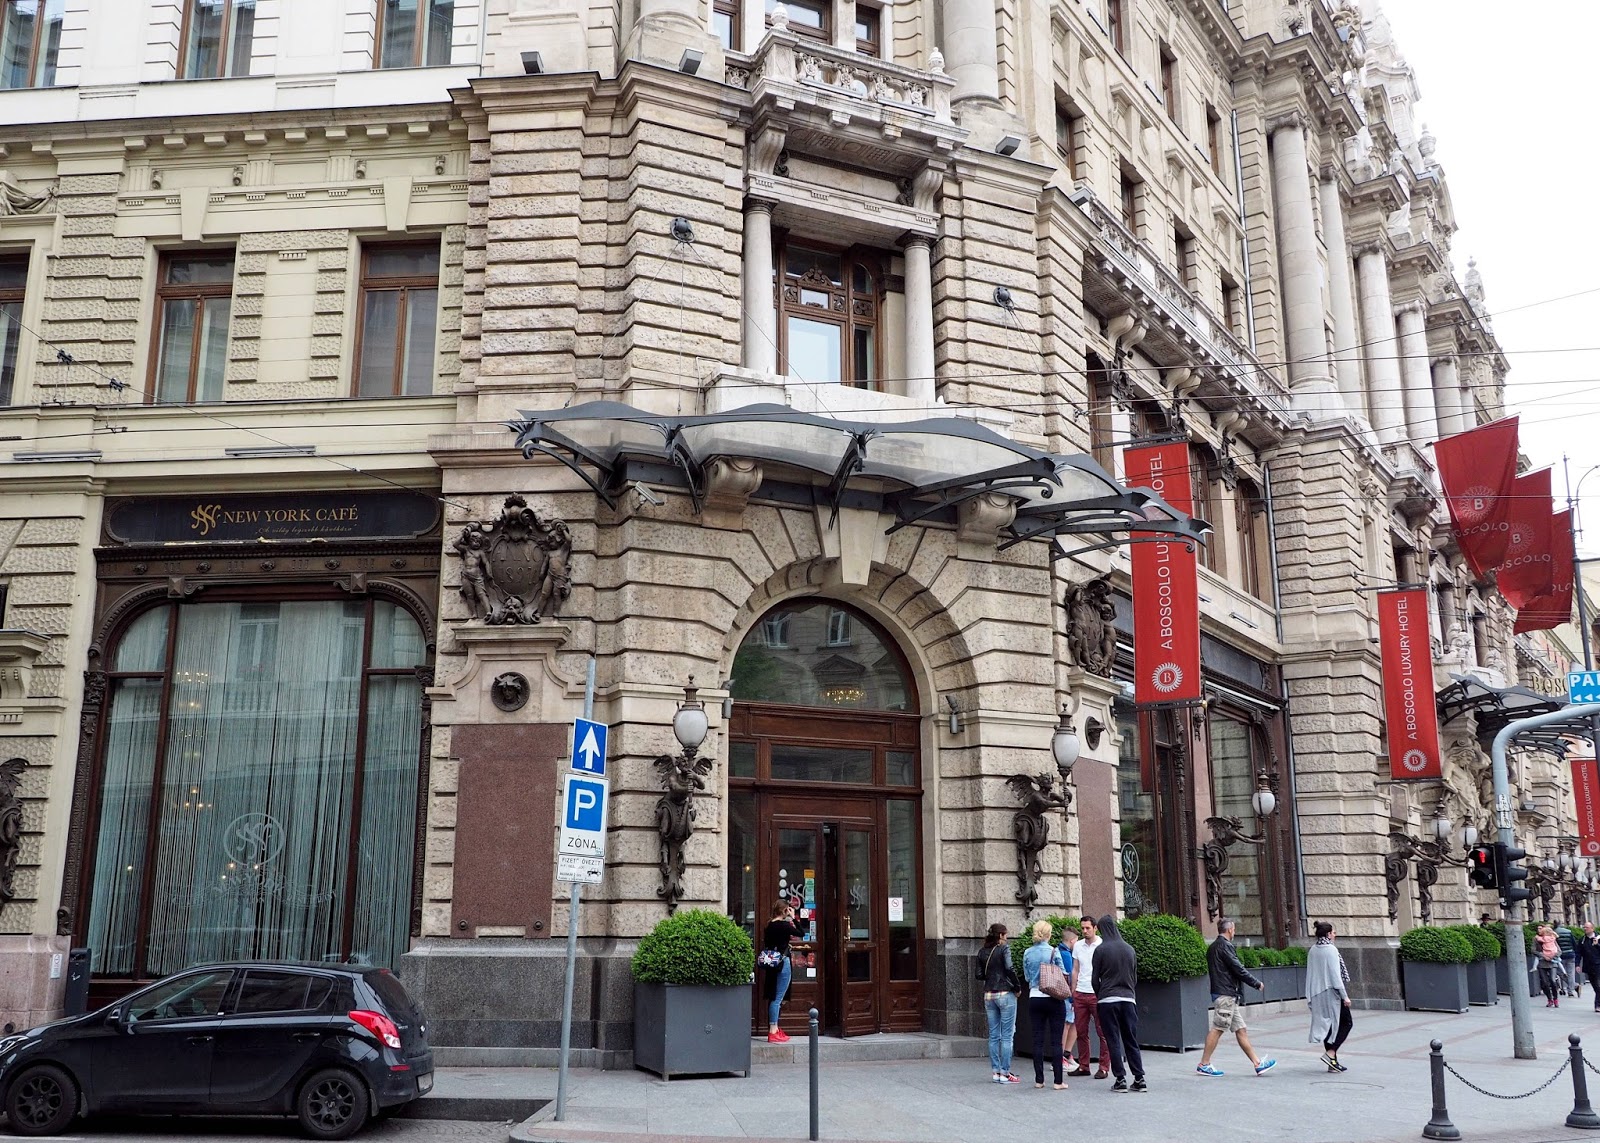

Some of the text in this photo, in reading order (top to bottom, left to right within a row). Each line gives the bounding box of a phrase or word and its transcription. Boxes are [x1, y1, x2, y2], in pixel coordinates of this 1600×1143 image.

[1473, 498, 1485, 510] B
[222, 511, 261, 524] NEW
[264, 508, 312, 522] YORK
[315, 504, 359, 521] CAFÉ
[1453, 522, 1509, 538] OSCOLO
[1512, 533, 1522, 544] B
[1494, 553, 1551, 573] OSCOLO
[1157, 566, 1173, 637] BOSCOLO
[1161, 639, 1173, 650] A
[1398, 596, 1418, 740] A BOSCOLO LUXURY HOTEL
[1164, 673, 1172, 683] B
[574, 788, 597, 821] P
[567, 834, 597, 849] ZÓNA
